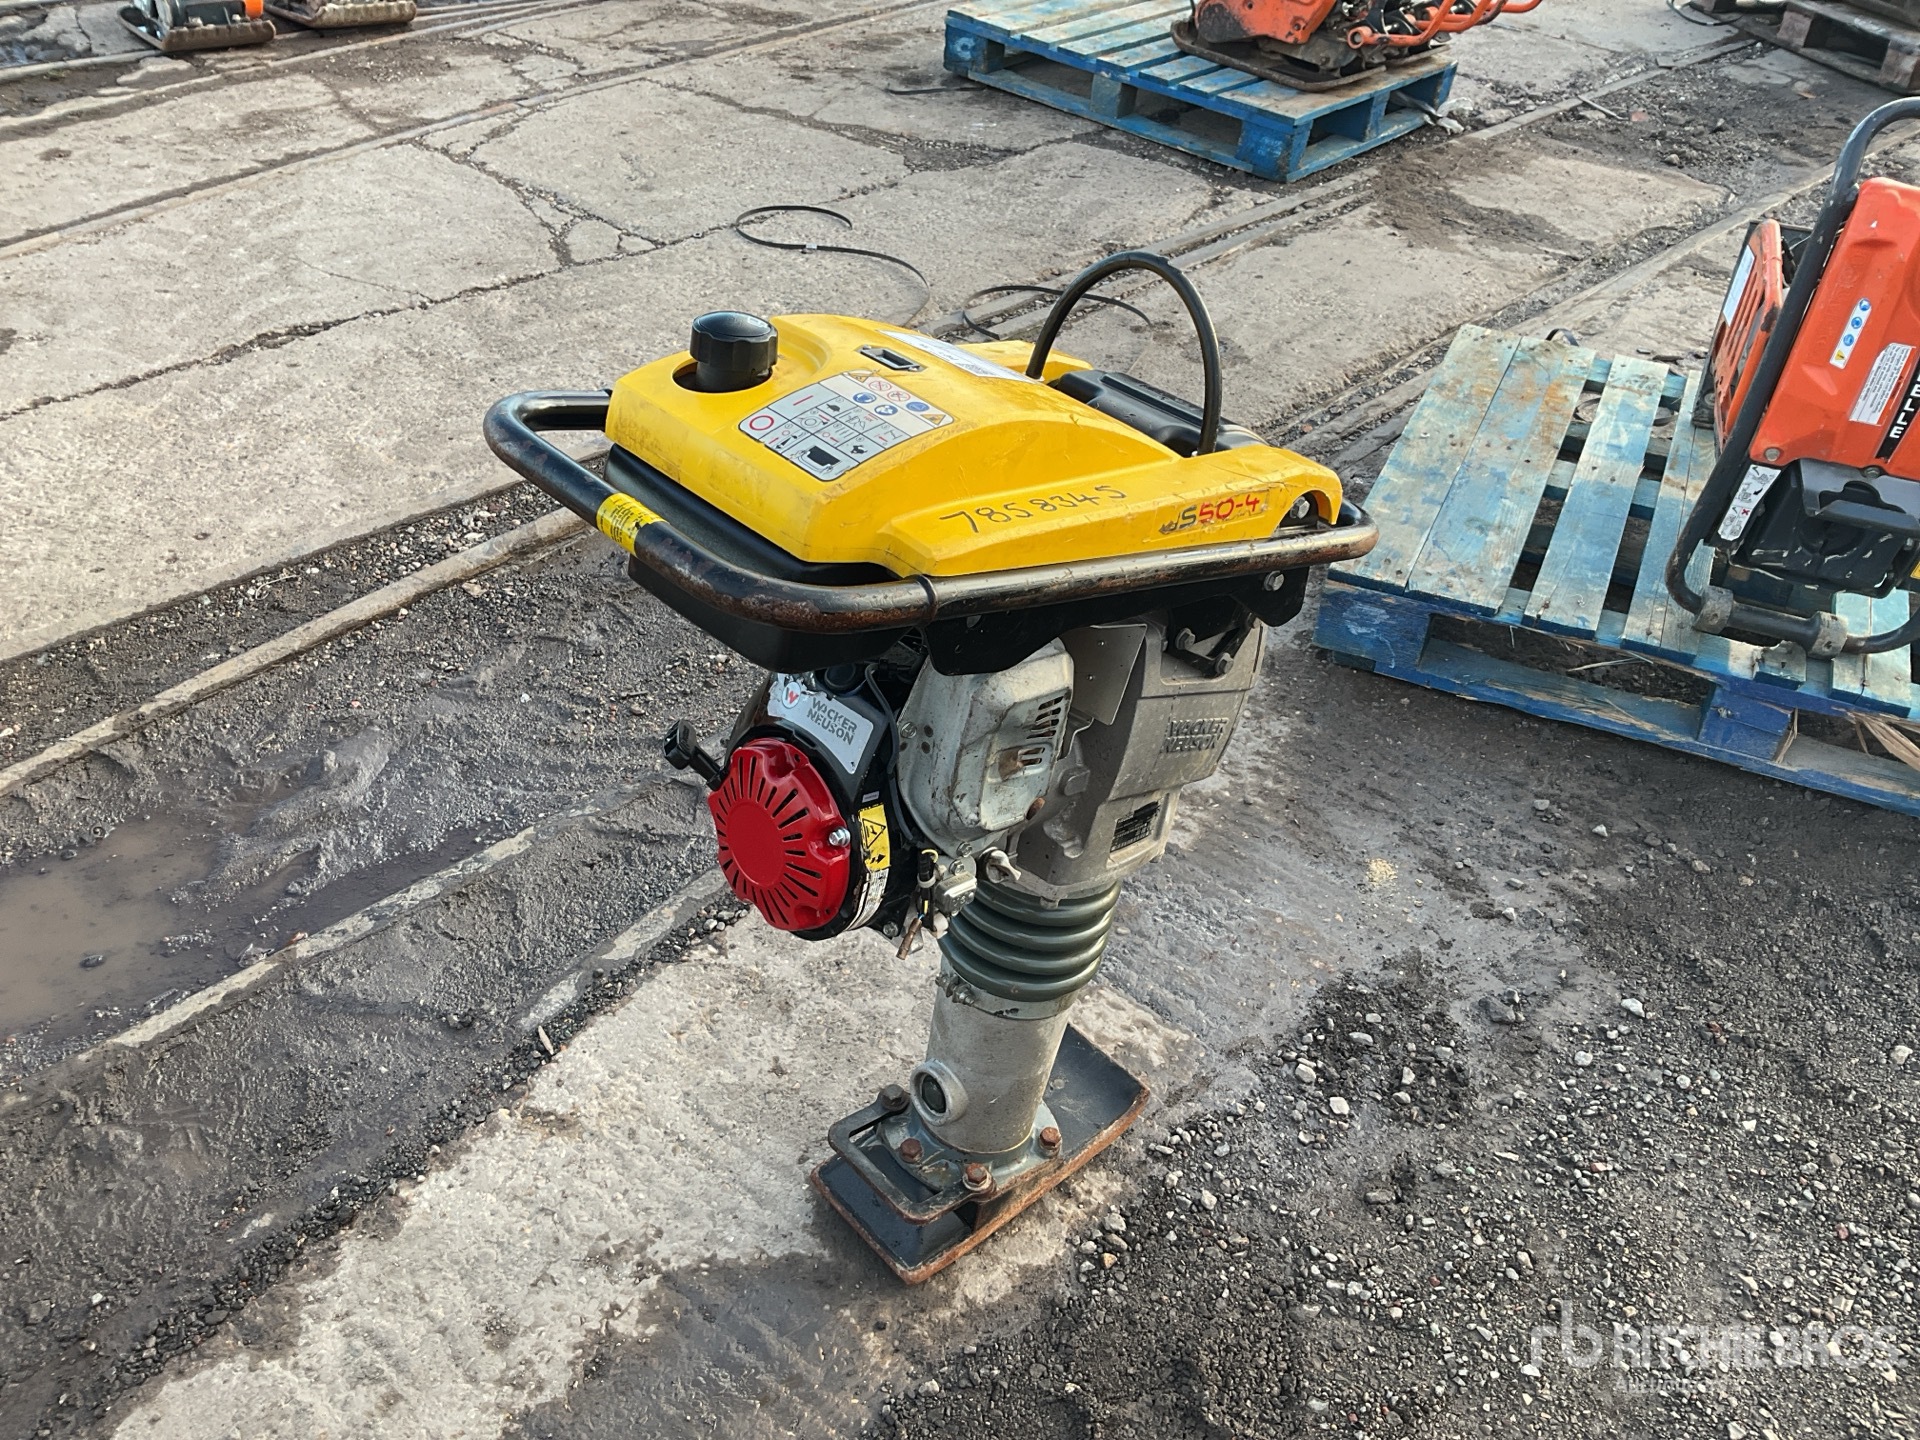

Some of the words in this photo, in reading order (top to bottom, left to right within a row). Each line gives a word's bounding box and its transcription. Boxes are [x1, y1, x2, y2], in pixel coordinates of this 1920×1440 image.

[1889, 374, 1920, 438] ELLE
[939, 485, 1127, 533] 7858345
[806, 708, 855, 746] NEUSON
[811, 696, 858, 734] WACKER
